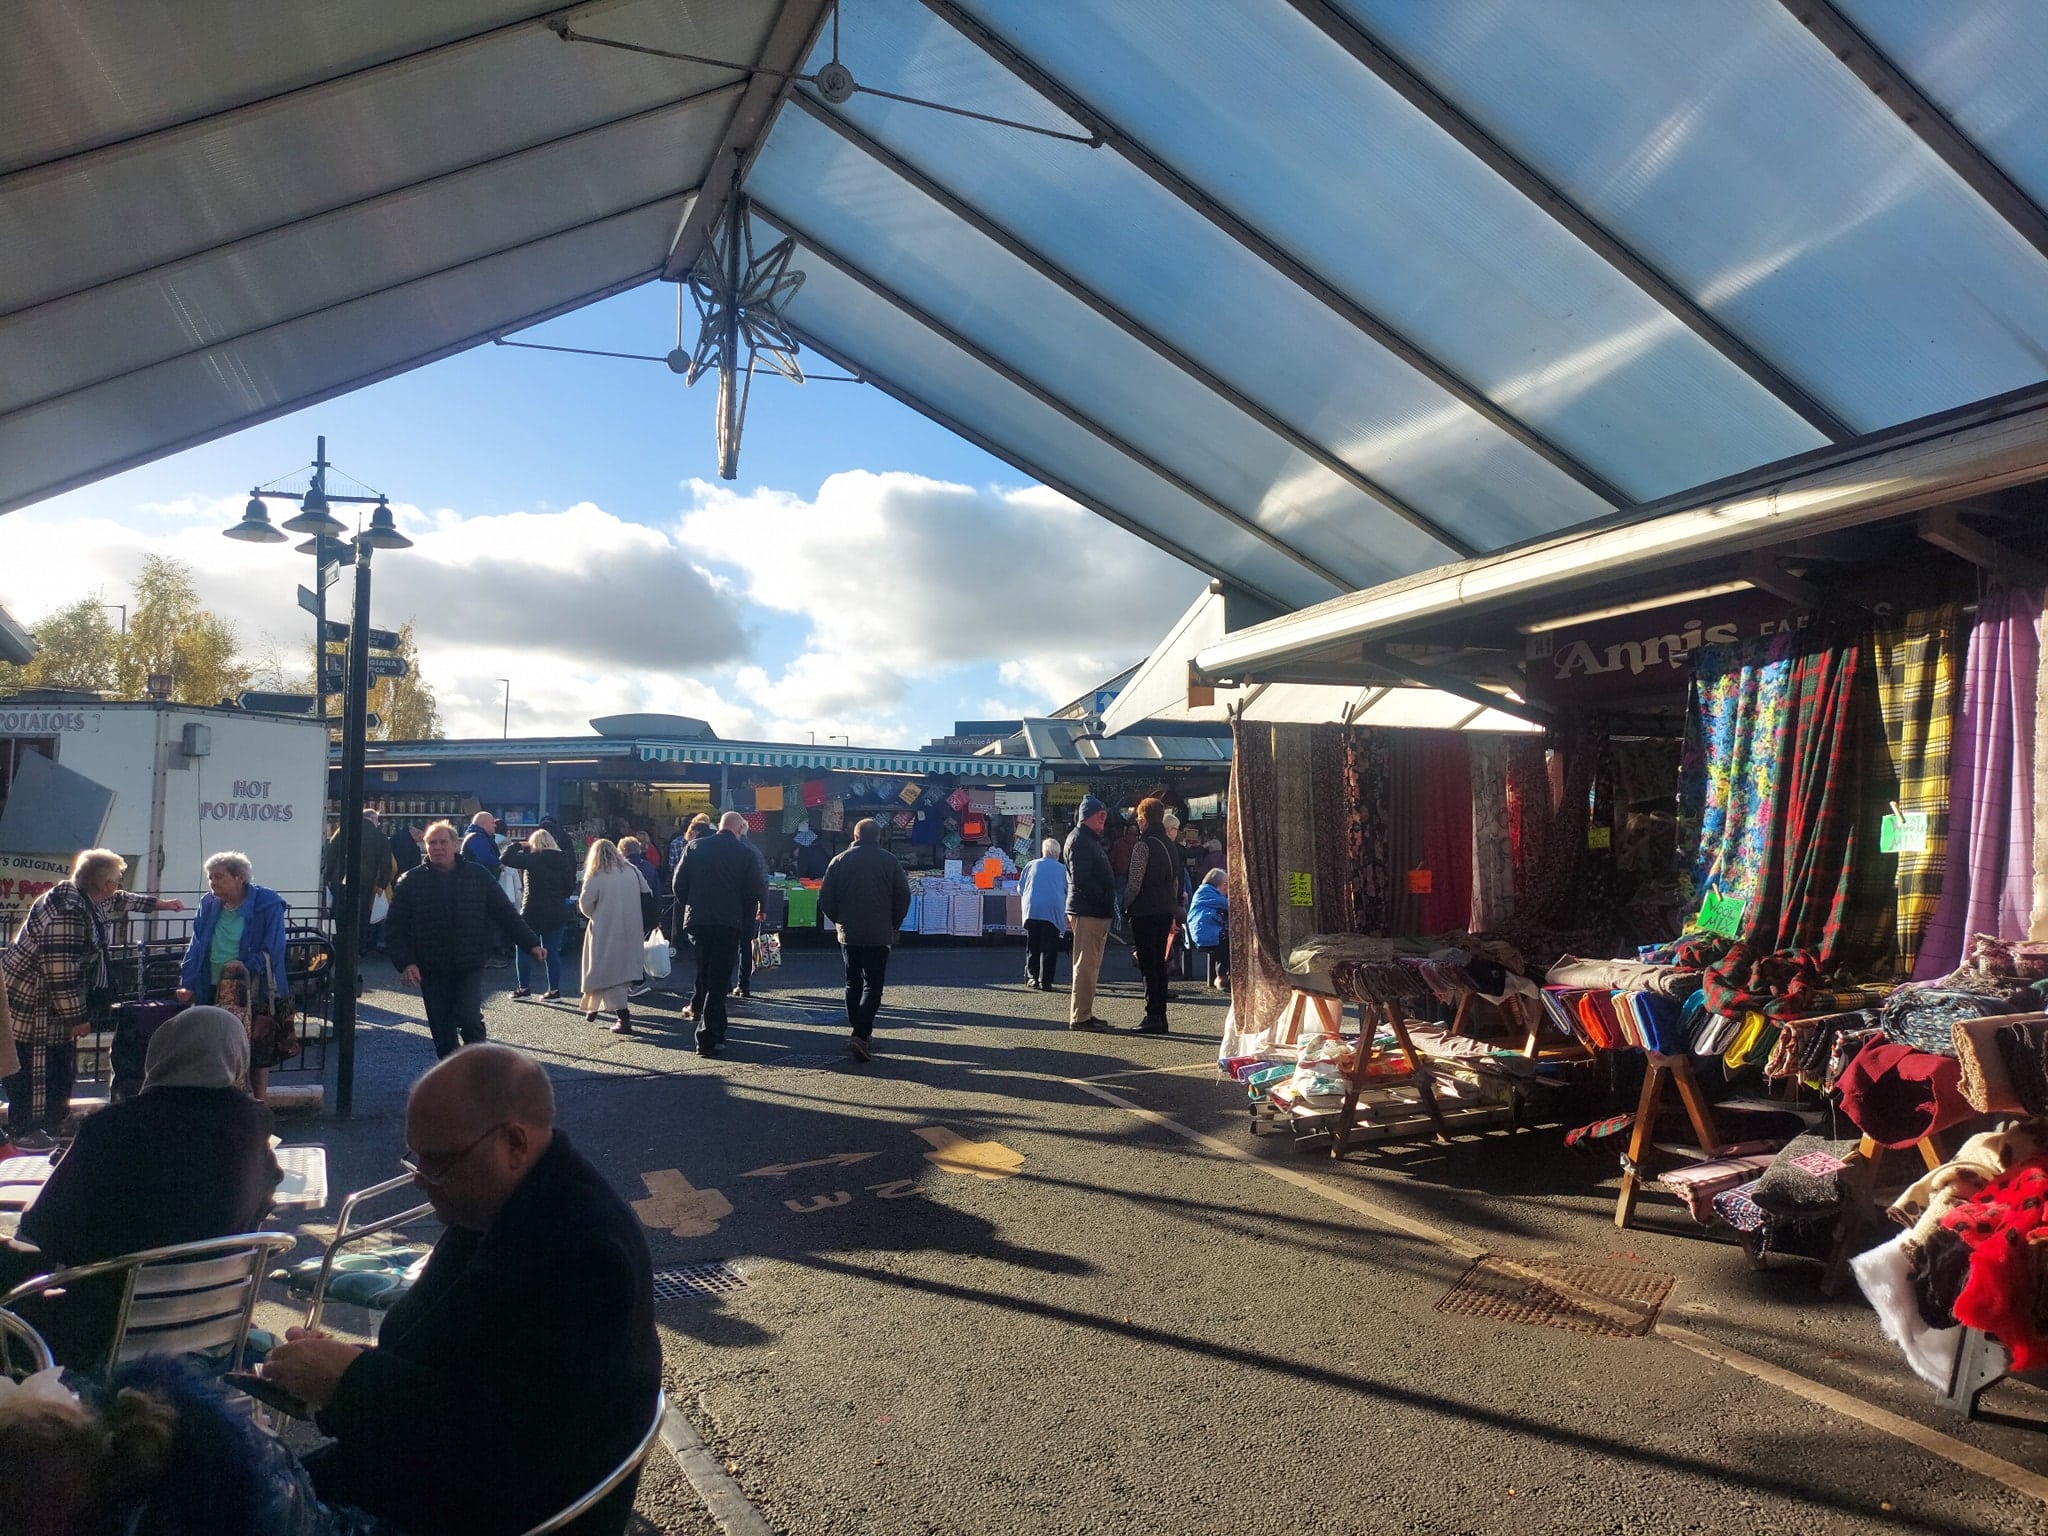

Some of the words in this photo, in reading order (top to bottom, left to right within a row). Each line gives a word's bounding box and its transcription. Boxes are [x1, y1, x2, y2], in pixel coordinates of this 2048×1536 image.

[1554, 620, 1739, 679] Annis
[233, 779, 272, 799] HOT
[201, 802, 293, 822] POTATOES
[12, 857, 70, 874] ORIGINAL
[1708, 898, 1735, 919] WOOL
[1702, 915, 1734, 932] MIX
